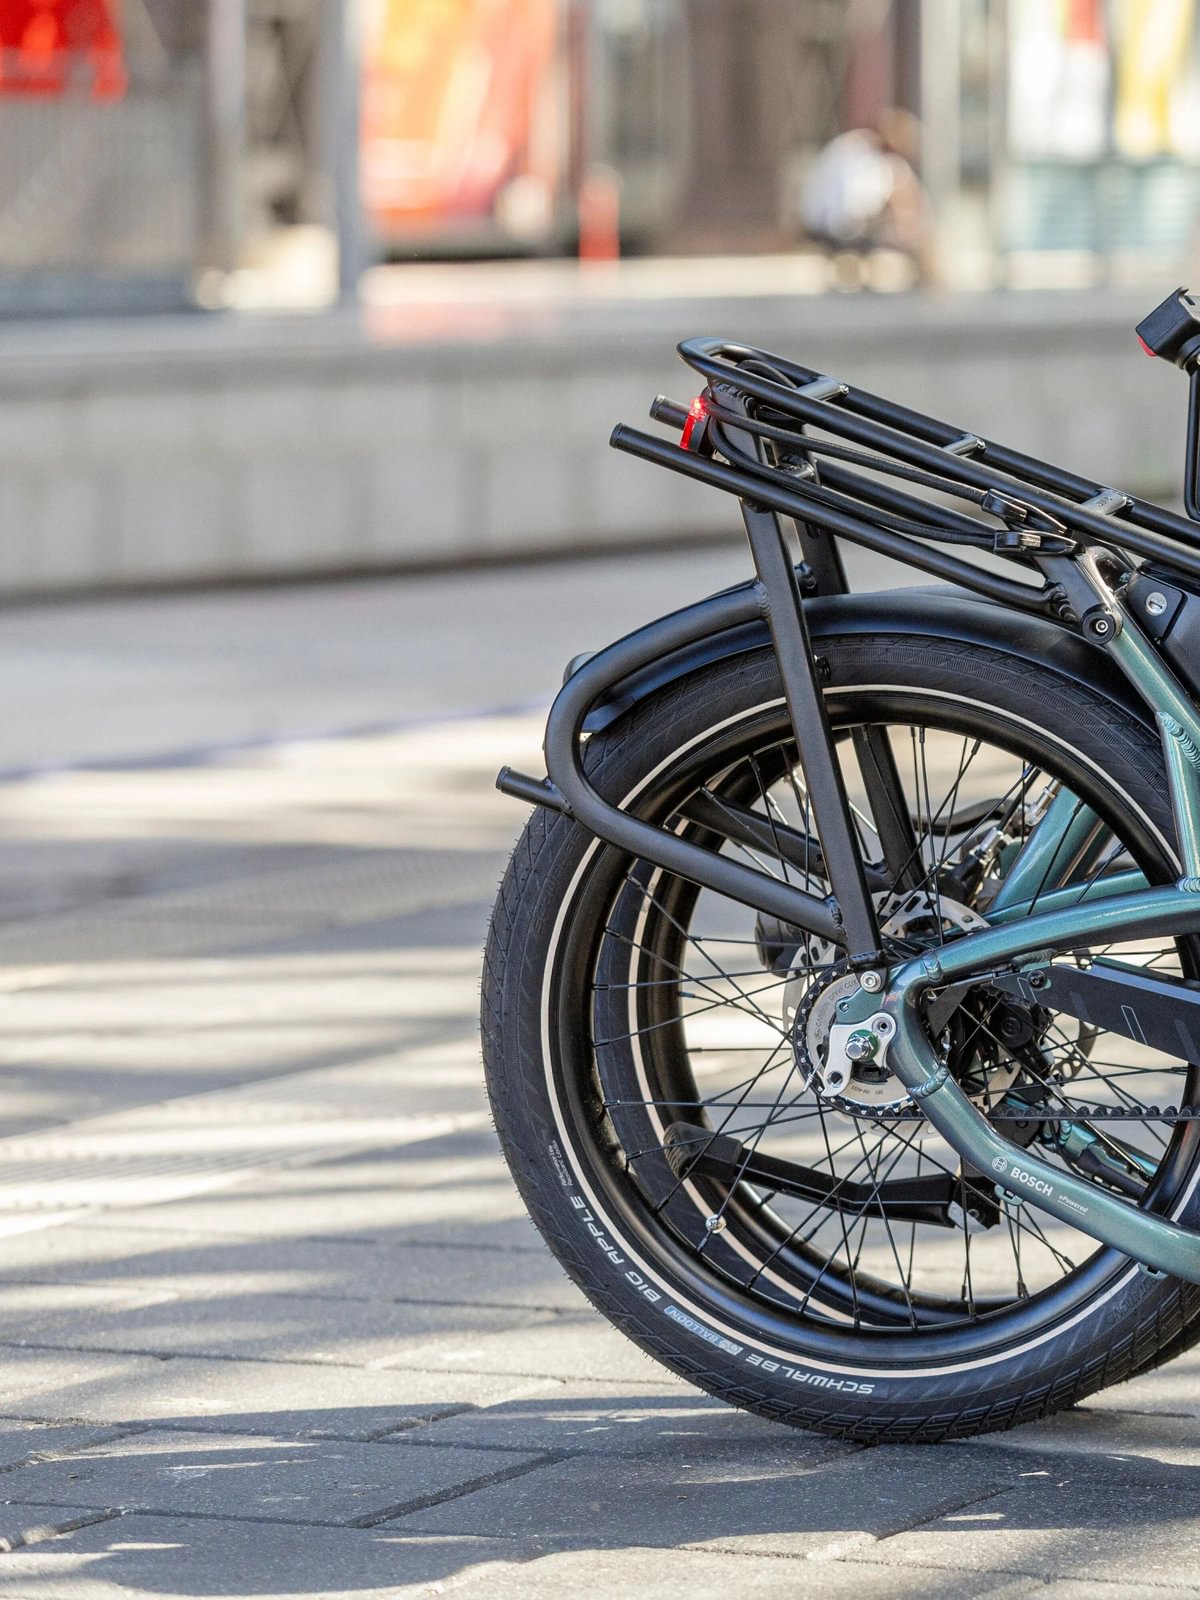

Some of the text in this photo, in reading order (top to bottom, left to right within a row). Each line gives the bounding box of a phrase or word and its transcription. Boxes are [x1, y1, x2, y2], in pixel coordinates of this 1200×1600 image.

[1010, 1166, 1089, 1213] BOSCH ePowered
[570, 1195, 662, 1303] BIG APPLE
[670, 1308, 876, 1396] SCHWALBE BALLOON
